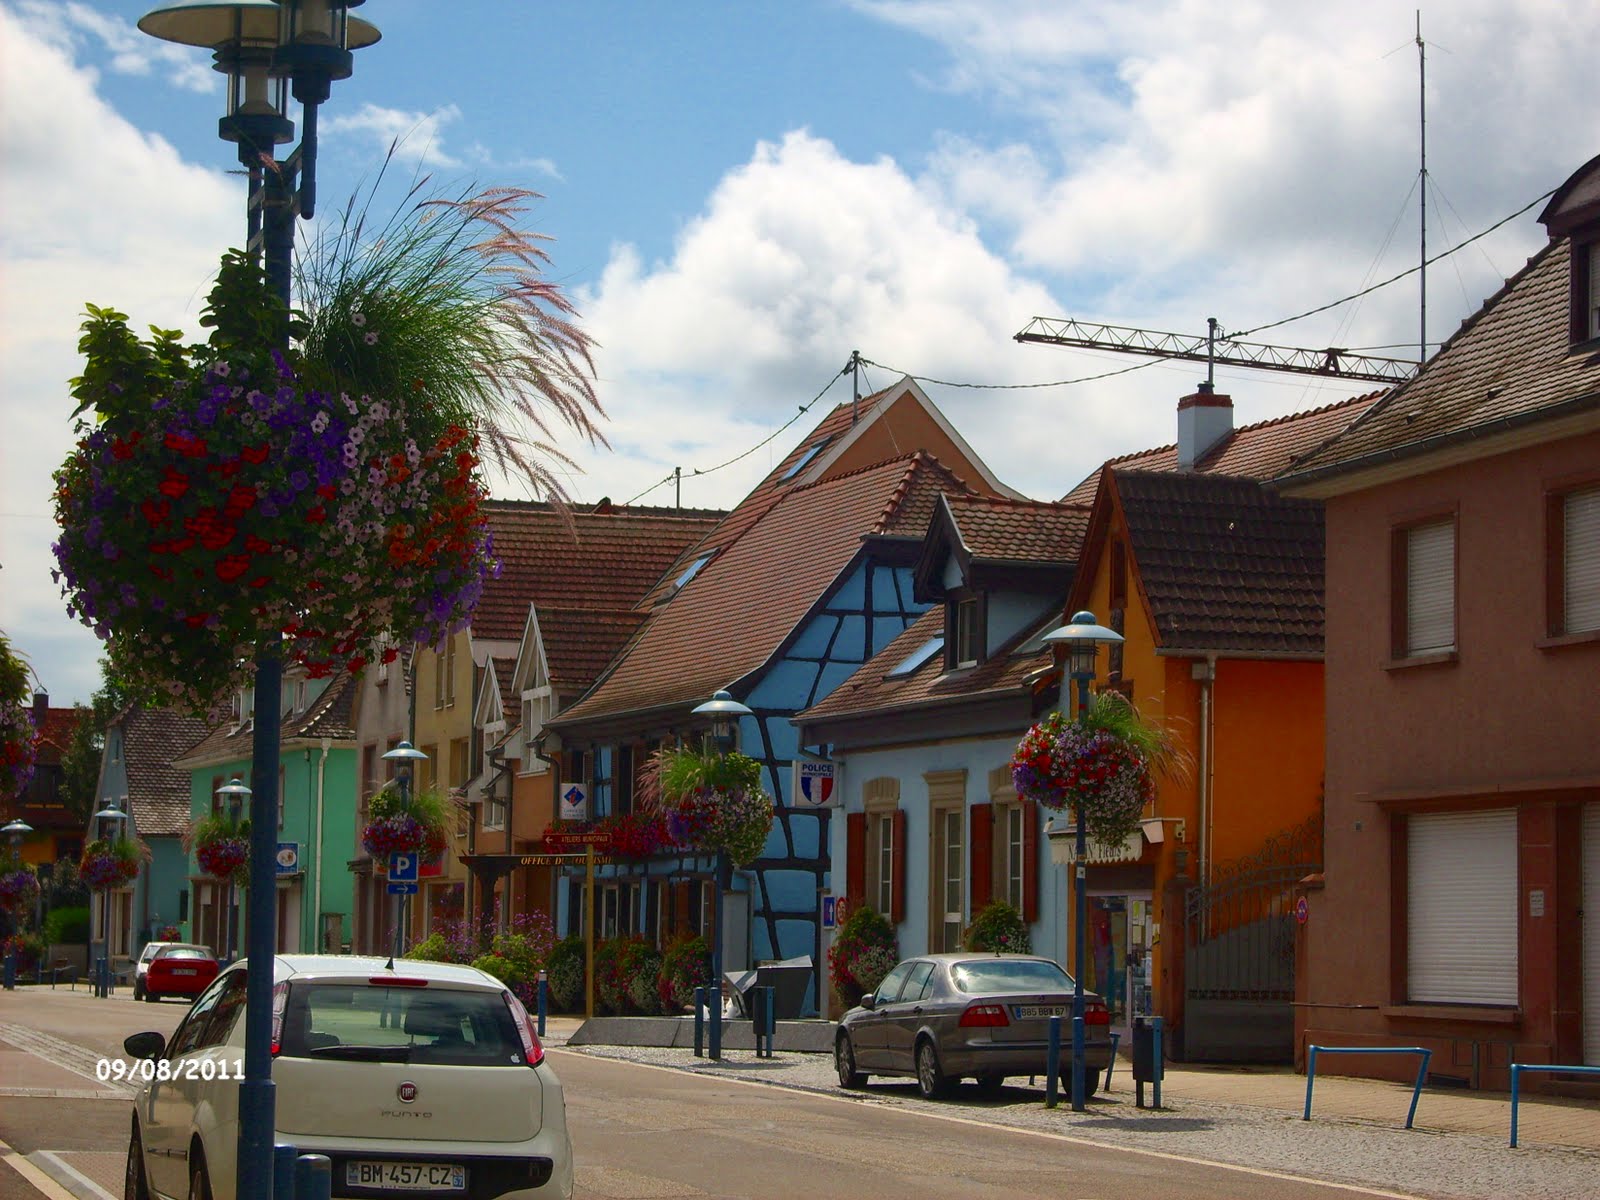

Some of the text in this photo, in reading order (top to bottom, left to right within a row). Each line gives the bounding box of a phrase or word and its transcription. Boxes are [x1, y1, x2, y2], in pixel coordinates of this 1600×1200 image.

[802, 764, 833, 772] POLICE
[397, 857, 410, 875] P
[520, 857, 552, 865] OFFICE
[360, 1165, 451, 1185] BM-457-CZ
